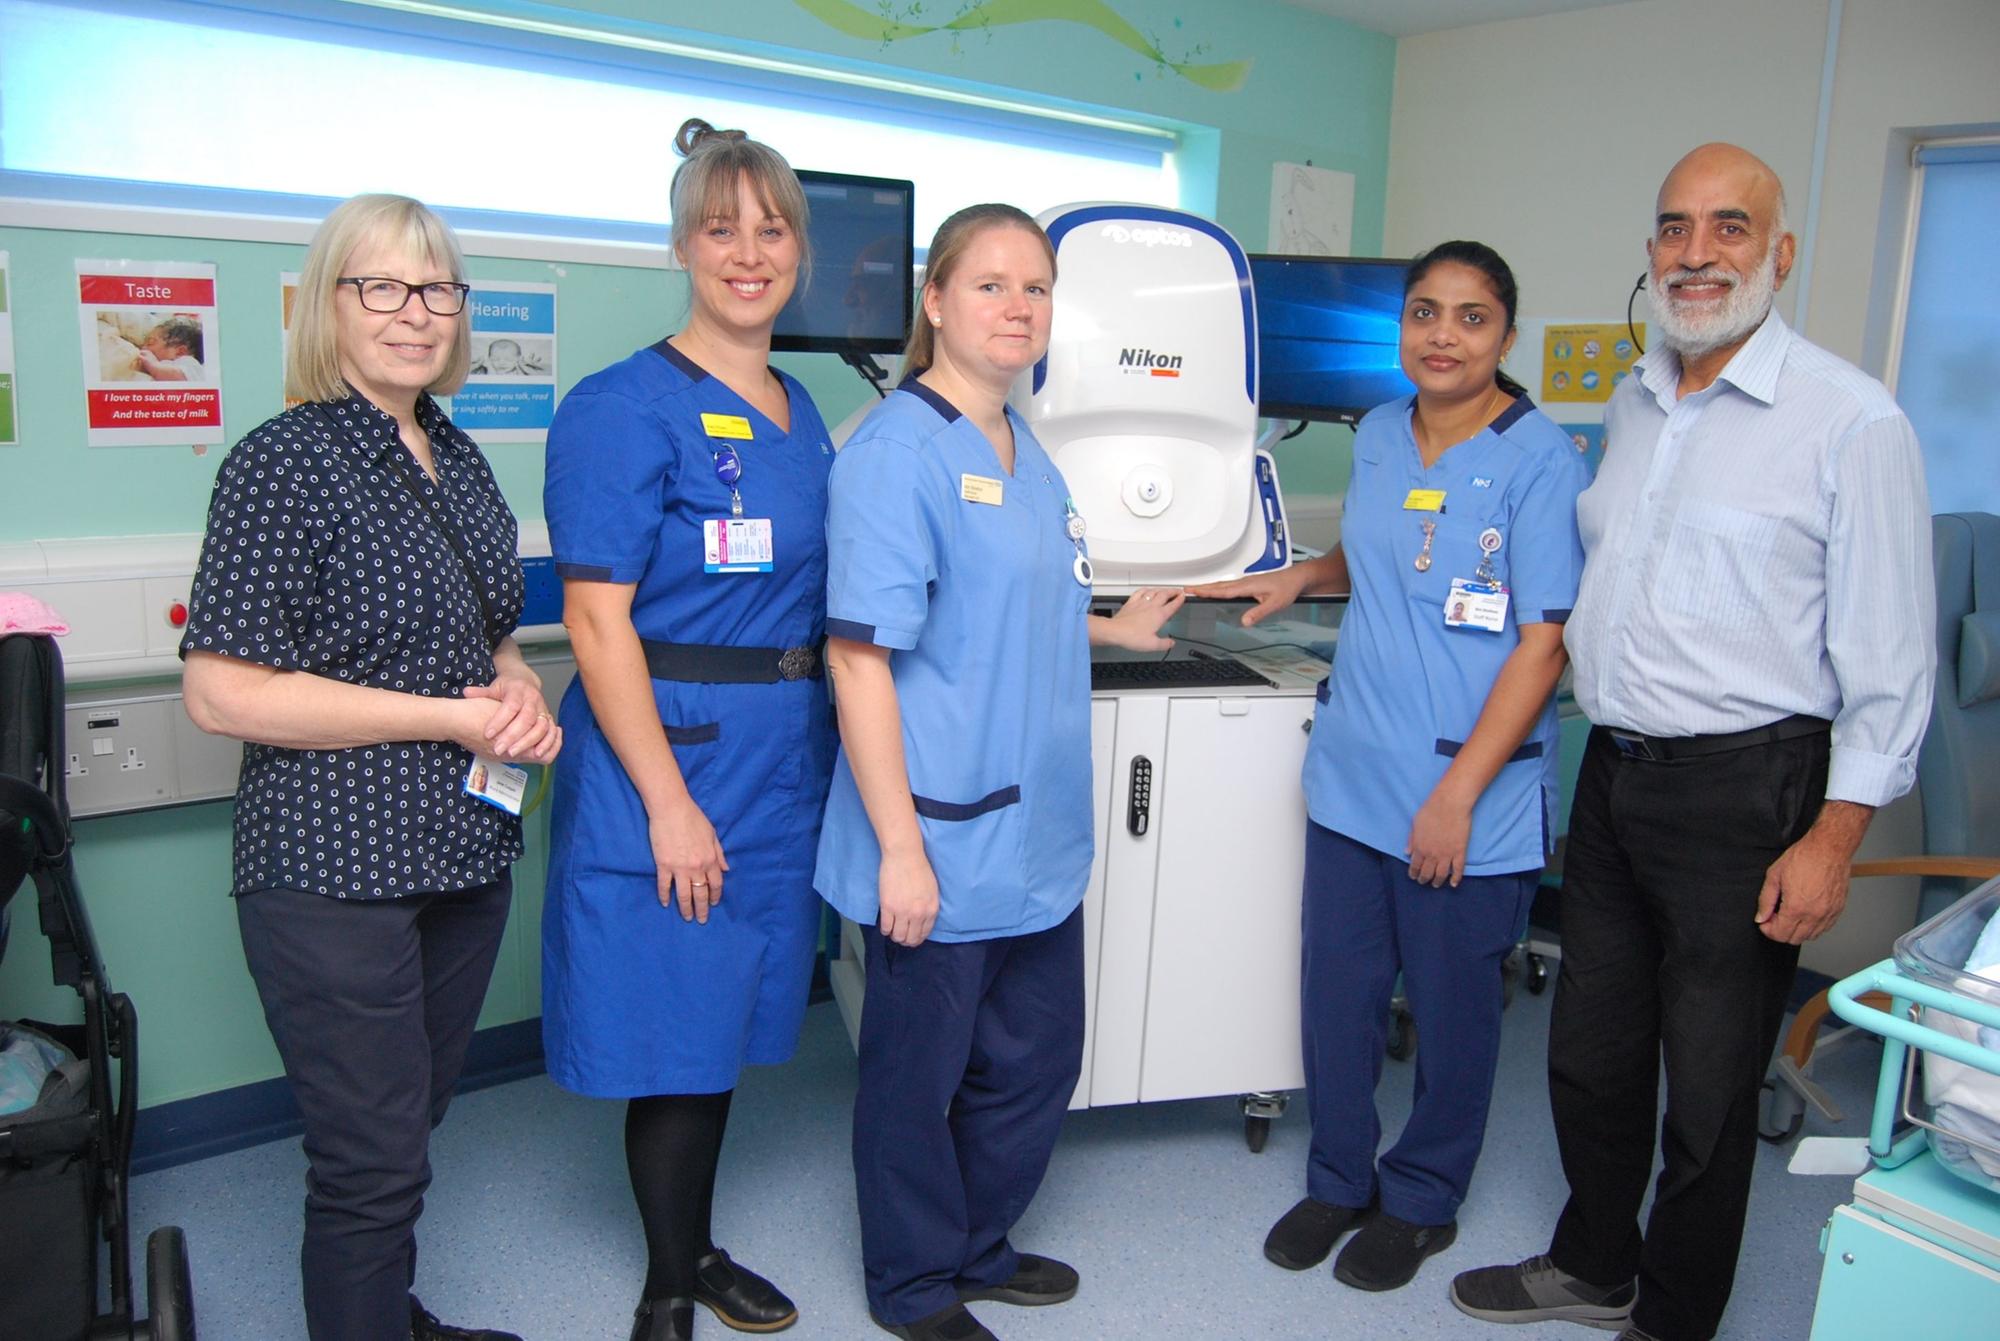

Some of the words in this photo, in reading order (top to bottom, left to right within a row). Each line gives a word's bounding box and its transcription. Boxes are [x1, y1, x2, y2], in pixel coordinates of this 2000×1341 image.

[124, 282, 172, 299] Taste
[471, 301, 530, 321] Hearing
[1118, 348, 1183, 369] Nikon
[110, 393, 130, 402] love
[132, 393, 143, 402] to
[144, 392, 166, 402] suck
[167, 393, 181, 403] my
[182, 392, 215, 403] fingers
[500, 393, 514, 401] you
[112, 410, 133, 419] And
[134, 409, 150, 419] the
[152, 409, 176, 419] taste
[177, 408, 188, 420] of
[188, 408, 209, 418] milk
